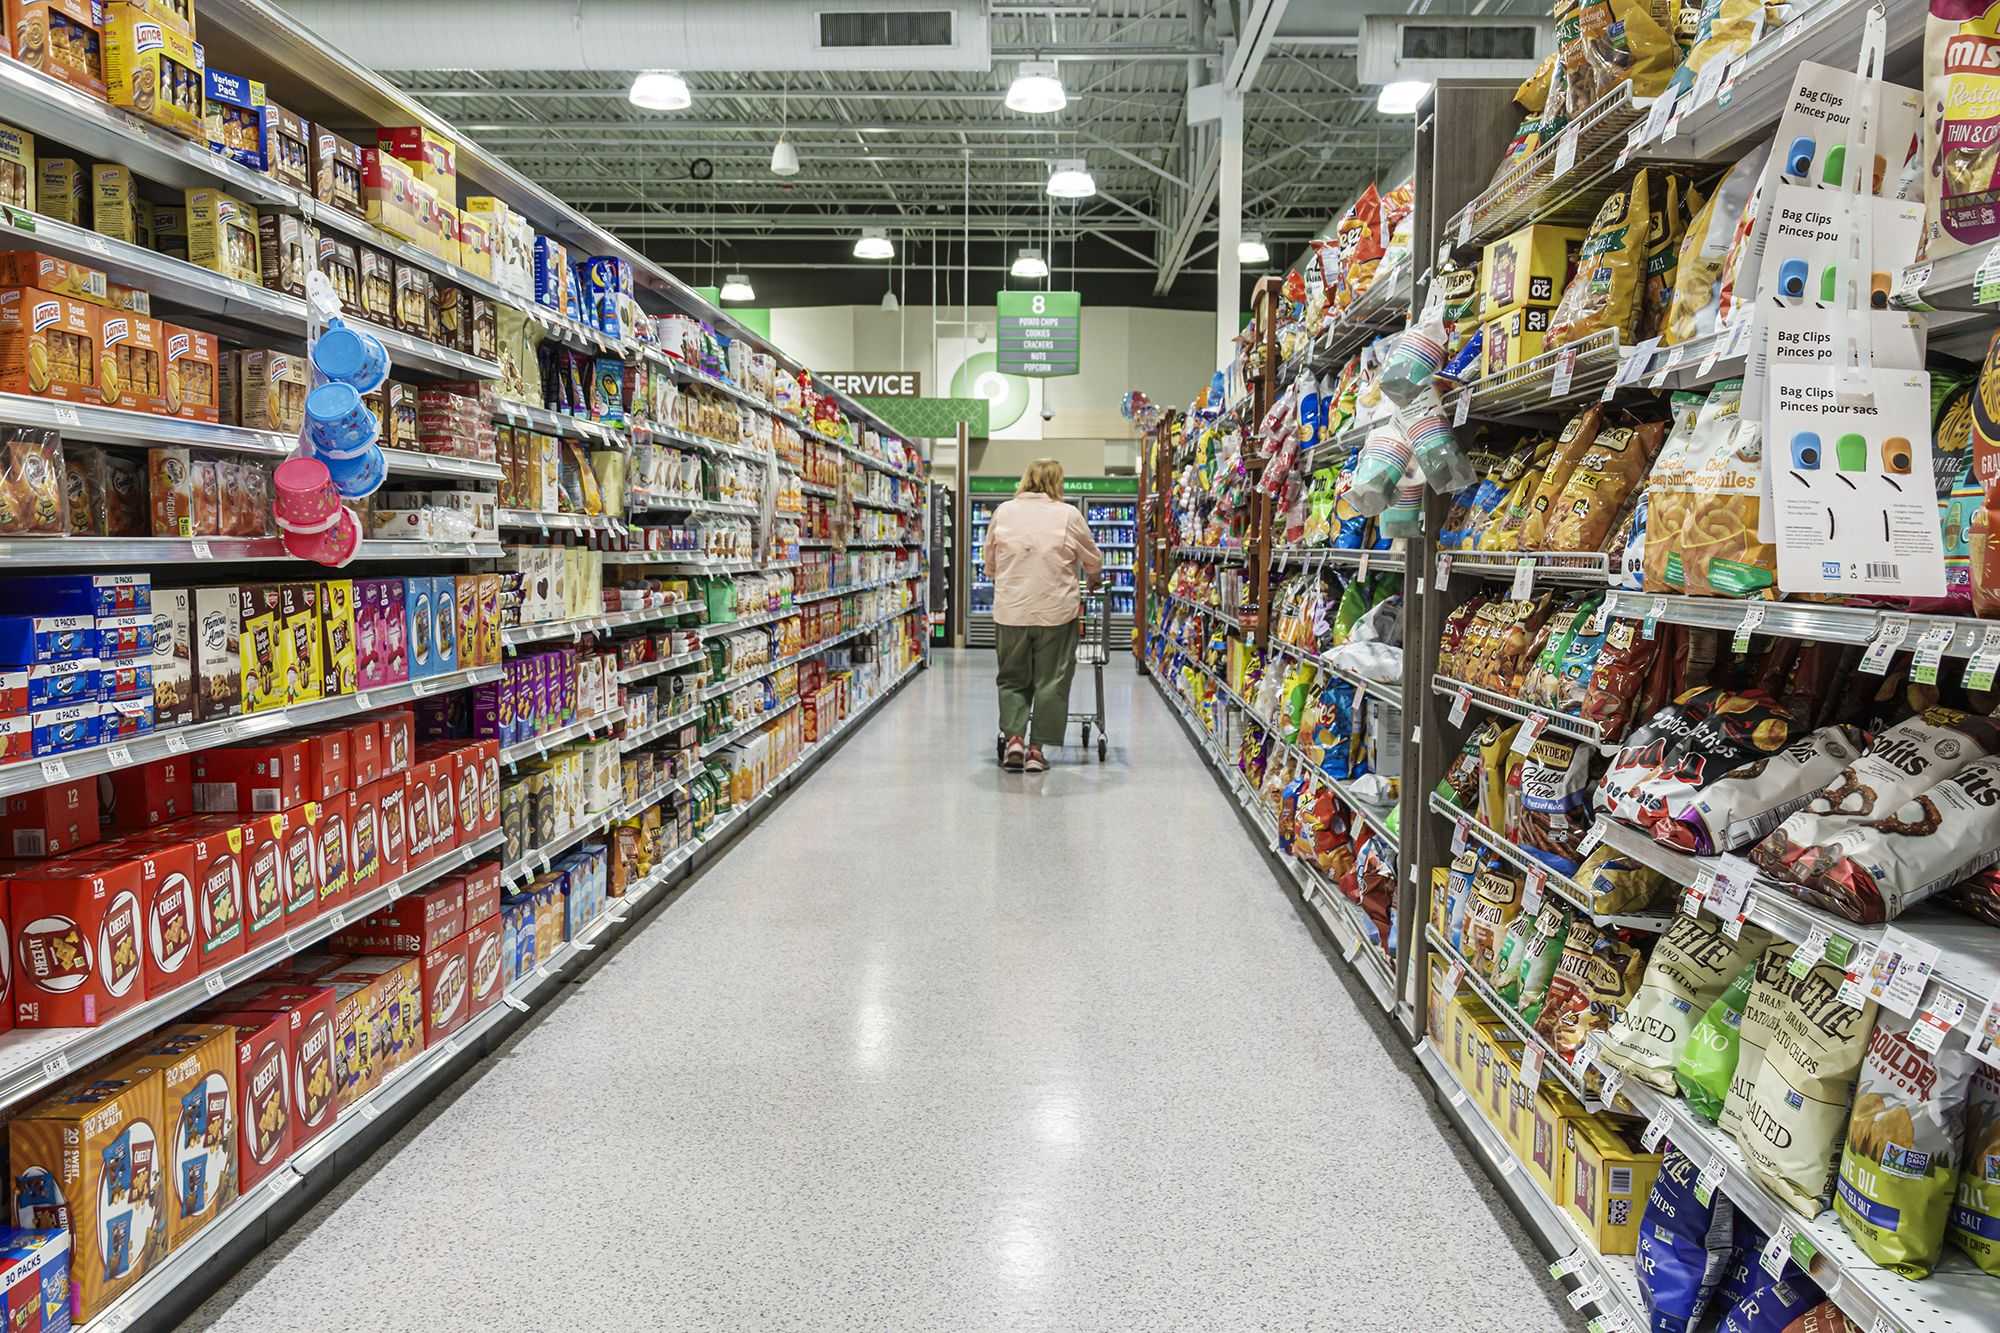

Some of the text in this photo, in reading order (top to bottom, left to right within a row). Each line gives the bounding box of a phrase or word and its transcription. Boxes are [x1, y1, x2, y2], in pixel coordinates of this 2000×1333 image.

[136, 25, 162, 43] Lance
[211, 72, 240, 89] Variety
[218, 82, 238, 97] Pack
[1799, 86, 1843, 107] Bag Clips
[1794, 102, 1851, 127] Pinces pour
[0, 128, 23, 146] ptain's
[1948, 125, 1970, 142] THIN
[1971, 125, 1982, 143] &
[102, 171, 119, 180] Lance
[1782, 208, 1832, 226] Bag Clips
[1778, 224, 1838, 242] Pinces pou
[1532, 284, 1550, 297] 20
[2, 307, 19, 315] Toast
[68, 302, 85, 316] Toast
[1032, 295, 1046, 314] 8
[35, 306, 59, 325] Lance
[1040, 317, 1058, 327] CHIPS
[1528, 311, 1542, 331] 20
[105, 322, 127, 341] Lance
[135, 319, 151, 333] Toast
[1025, 329, 1050, 338] COOKIES
[169, 336, 188, 354] Lance
[1023, 340, 1053, 349] CRACKERS
[1778, 331, 1831, 344] Bag Clips
[1031, 352, 1046, 361] NUTS
[1777, 346, 1833, 360] Pinces po
[1023, 363, 1051, 372] POPCORN
[1780, 386, 1834, 399] Bag Clips
[1780, 401, 1878, 415] Pinces pour sacs
[1064, 482, 1093, 490] RAGES
[120, 576, 133, 584] PACKS
[228, 593, 238, 604] 10
[283, 589, 293, 606] 12
[353, 586, 360, 600] 12
[380, 584, 387, 598] 12
[176, 595, 186, 607] 10
[242, 591, 253, 608] 12
[60, 618, 77, 627] PACKS
[123, 617, 136, 625] PACKS
[154, 619, 173, 633] amous
[203, 616, 226, 636] Famous
[1884, 623, 1901, 636] 5.49
[206, 628, 225, 647] Amos
[50, 662, 79, 674] 12 PACKS
[62, 709, 80, 720] PACKS
[1899, 727, 1931, 743] ORIGINAL
[165, 765, 175, 777] 12
[68, 788, 78, 803] 12
[1527, 781, 1557, 799] Free
[245, 828, 254, 841] 12
[196, 842, 207, 855] 12
[144, 860, 155, 874] 12
[93, 878, 105, 892] 12
[410, 935, 420, 952] 20
[19, 1002, 33, 1022] 12
[291, 1011, 300, 1023] 20
[1786, 1010, 1808, 1036] BRAND
[241, 1045, 250, 1057] 20
[1791, 1039, 1819, 1075] CHIPS
[46, 1060, 61, 1073] 9.49
[166, 1055, 198, 1082] 20 SWEET
[185, 1061, 201, 1080] SALTY
[1869, 1056, 1919, 1096] CANYON
[84, 1103, 118, 1133] 20 SWEET
[103, 1110, 123, 1131] SALTY
[70, 1128, 80, 1178] 20 SWEET
[1907, 1152, 1927, 1161] NON
[1906, 1157, 1926, 1166] GMO
[64, 1157, 72, 1184] SALTY
[1858, 1168, 1879, 1198] OIL
[1849, 1190, 1858, 1208] SEA
[1858, 1200, 1872, 1217] SALT
[1960, 1213, 1982, 1231] SALT
[1864, 1223, 1878, 1241] CHIPS
[1641, 1239, 1651, 1251] &
[1970, 1239, 1991, 1255] CHIPS
[5, 1254, 41, 1286] 30 PACKS
